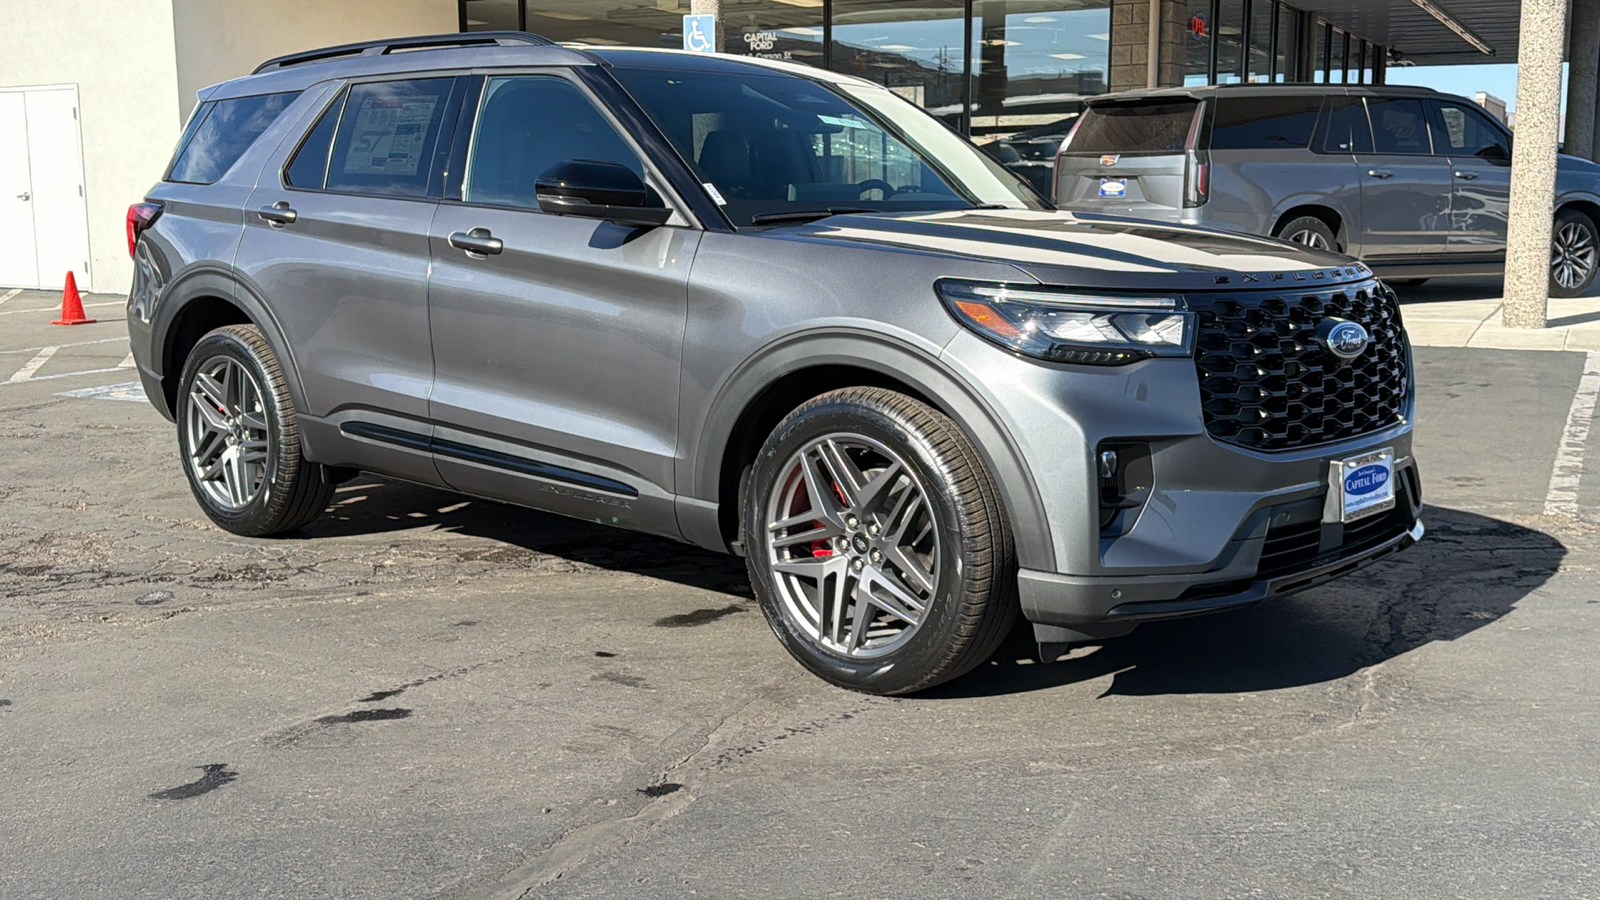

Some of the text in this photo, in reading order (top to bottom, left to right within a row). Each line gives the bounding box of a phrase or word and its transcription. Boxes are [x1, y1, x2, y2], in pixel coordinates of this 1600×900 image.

[744, 32, 778, 42] CAPITAL
[750, 41, 774, 50] FORD
[1213, 264, 1367, 284] EXPLORER
[1341, 329, 1362, 350] Ford
[1345, 472, 1387, 491] CAPITAL FORD
[540, 485, 630, 509] EXPLORER
